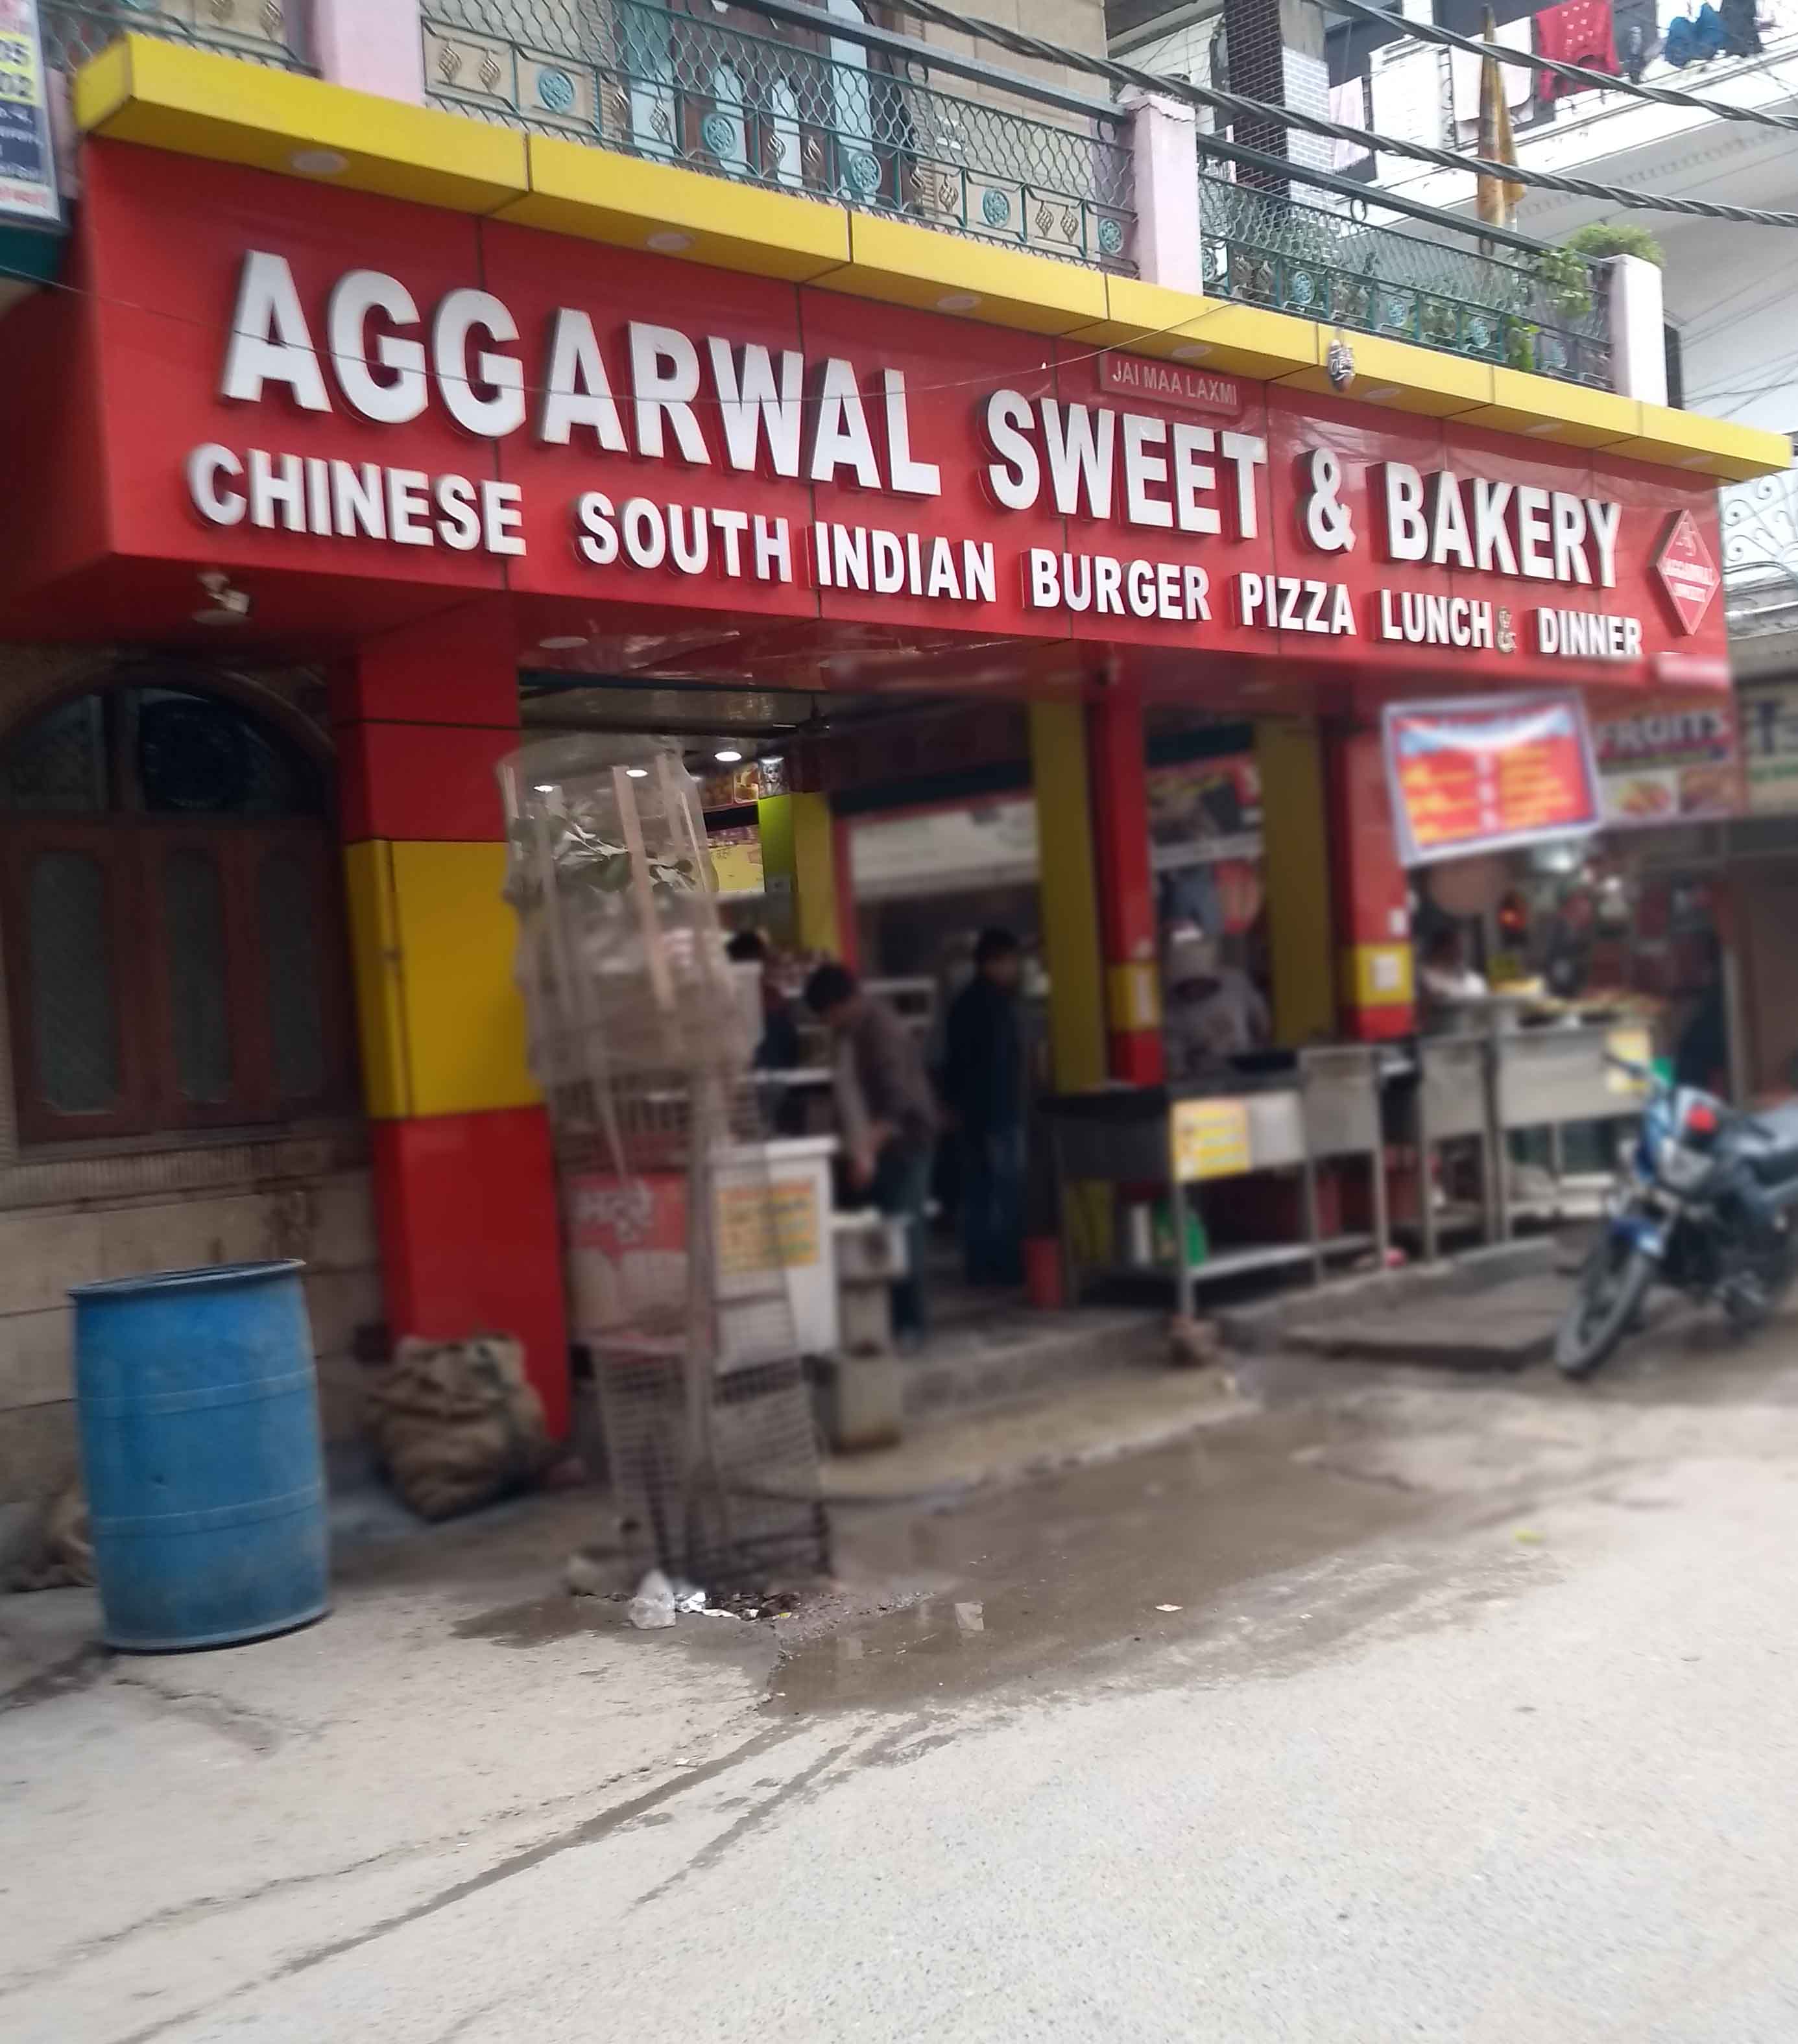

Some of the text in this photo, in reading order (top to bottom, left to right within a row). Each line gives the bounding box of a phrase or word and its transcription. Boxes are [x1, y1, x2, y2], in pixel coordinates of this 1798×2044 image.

[219, 250, 1621, 588] AGGARWAL SWEET & BAKERY
[1111, 361, 1237, 405] JAI MAA LAXMI
[187, 442, 527, 556] CHINESE
[577, 491, 793, 583] SOUTH
[814, 521, 996, 602] INDIAN
[1030, 547, 1212, 621] BURGER
[1238, 571, 1357, 636] PIZZA
[1379, 588, 1493, 648] LUNCH
[1537, 607, 1643, 659] DINNER
